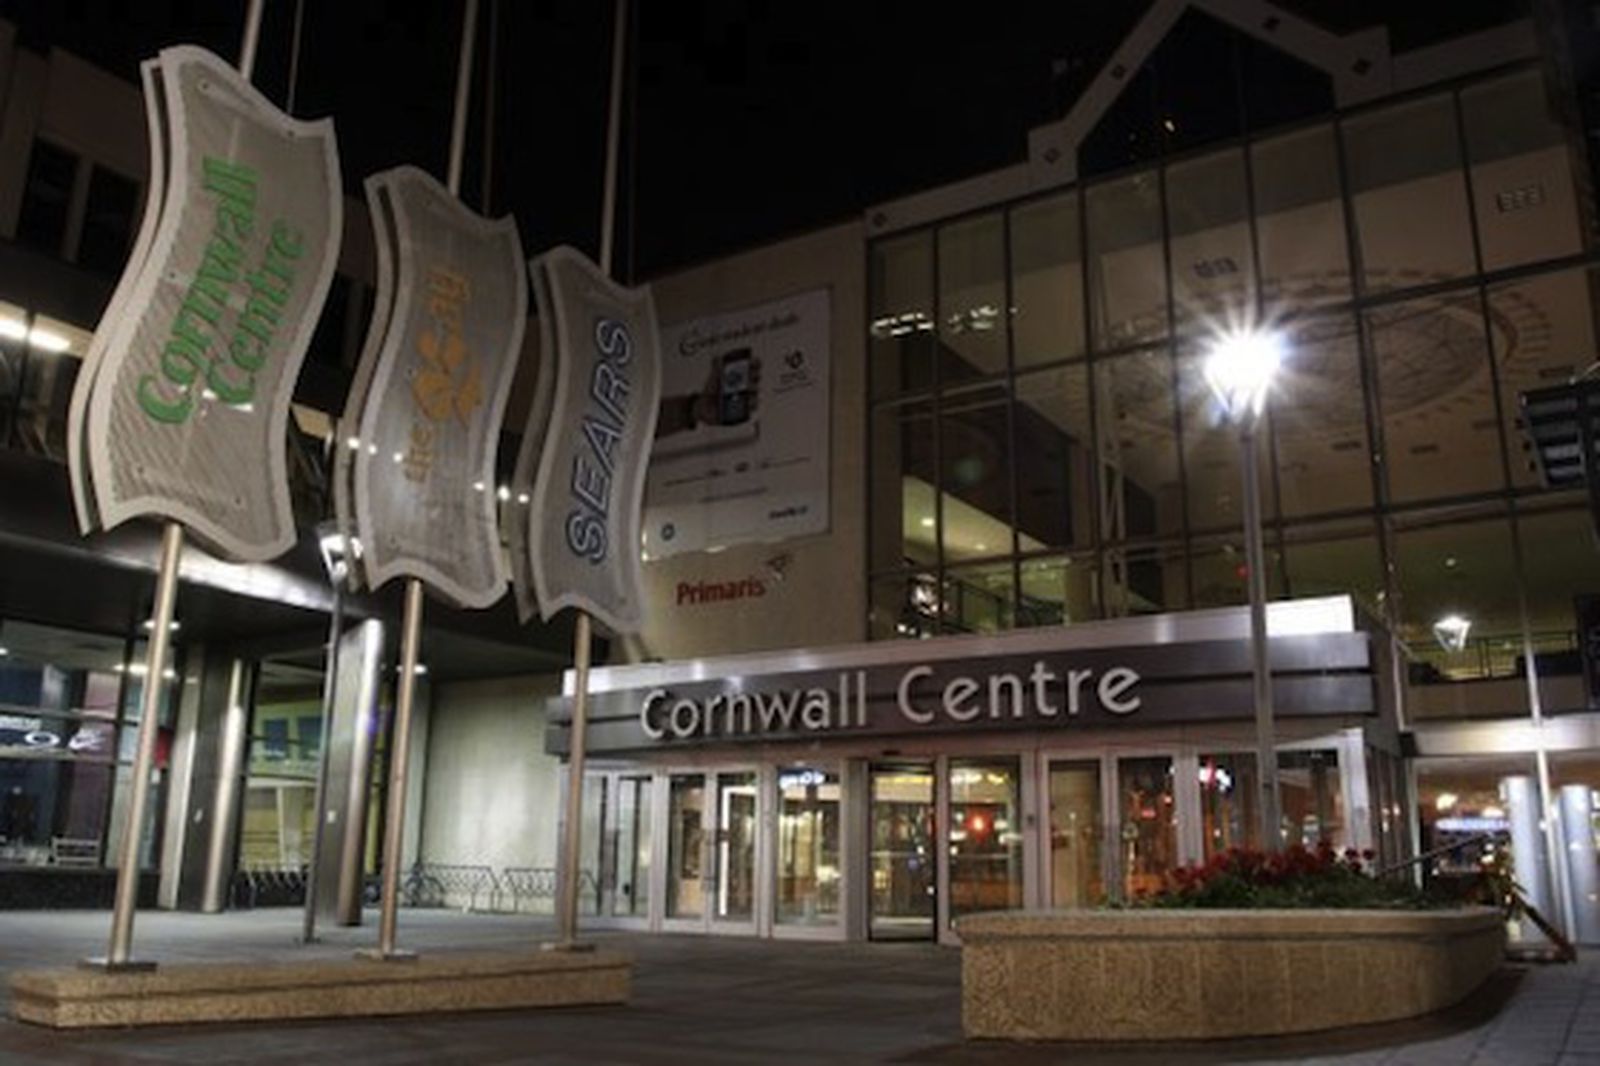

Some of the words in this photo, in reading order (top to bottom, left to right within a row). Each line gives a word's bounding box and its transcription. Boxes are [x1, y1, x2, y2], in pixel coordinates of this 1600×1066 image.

[137, 158, 259, 424] Cornwall
[205, 222, 304, 404] Centre
[566, 318, 632, 565] SEARS
[677, 577, 766, 606] Primaris
[641, 671, 866, 739] Cornwall
[899, 662, 1140, 723] Centre
